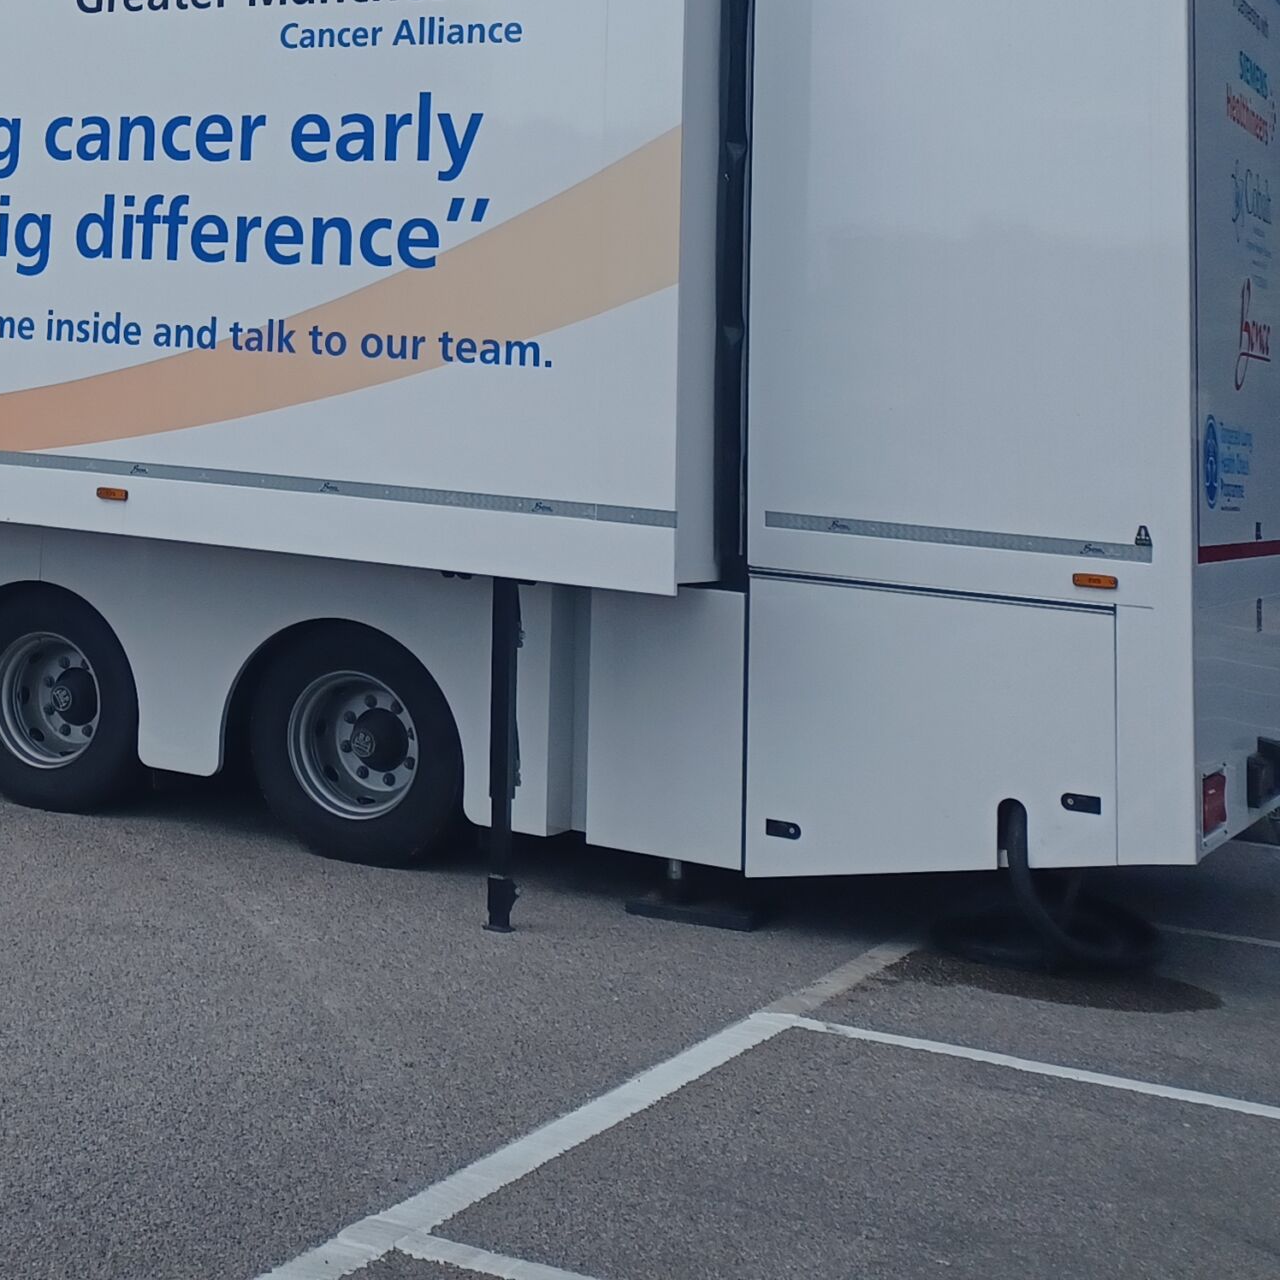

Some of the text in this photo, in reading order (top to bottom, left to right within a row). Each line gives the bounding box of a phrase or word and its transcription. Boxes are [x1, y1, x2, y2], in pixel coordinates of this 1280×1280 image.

[280, 16, 522, 49] Cancer Alliance
[45, 114, 266, 162] cancer
[291, 92, 484, 181] early
[47, 309, 141, 345] inside
[153, 316, 217, 350] and
[229, 319, 296, 353] talk
[309, 325, 347, 356] to
[361, 333, 426, 360] our
[438, 331, 552, 368] team.
